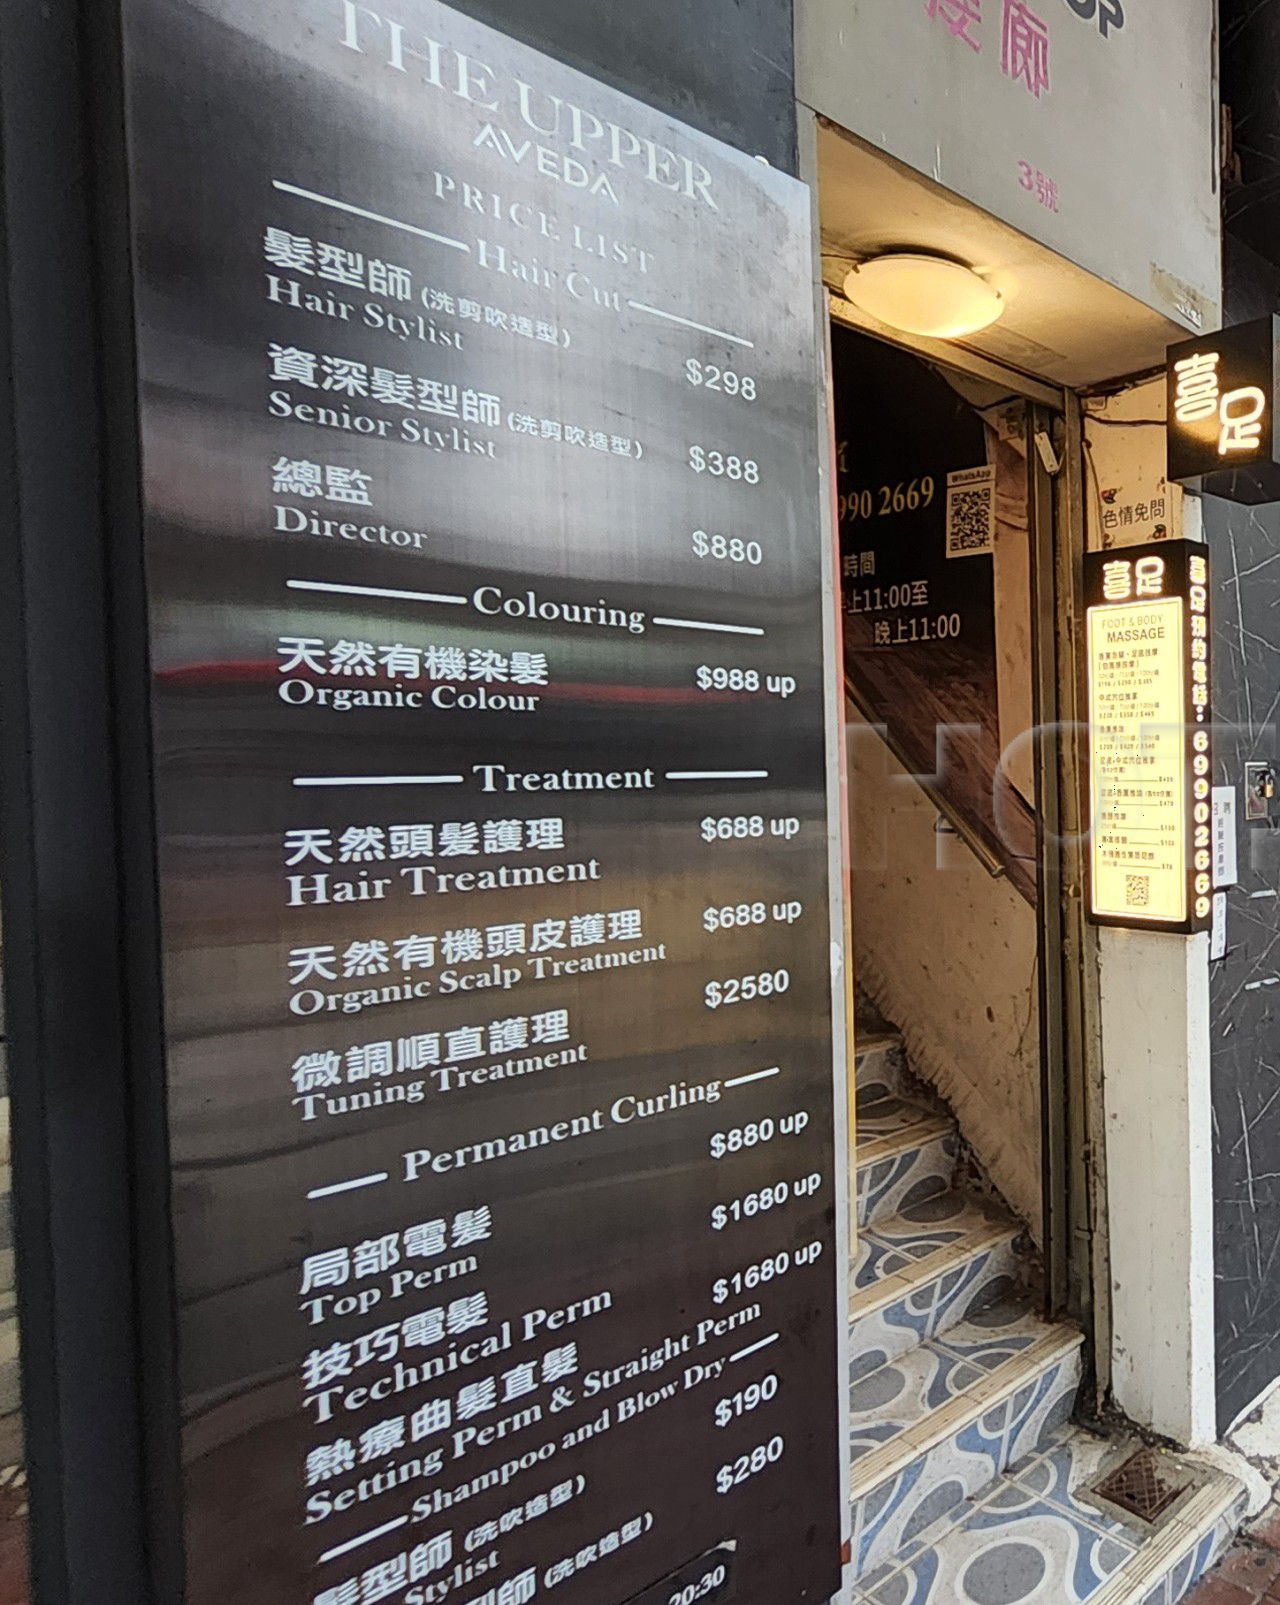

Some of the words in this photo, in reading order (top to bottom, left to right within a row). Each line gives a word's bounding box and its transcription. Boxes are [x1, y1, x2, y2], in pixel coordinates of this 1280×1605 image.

[338, 0, 501, 113] THE
[519, 79, 719, 210] UPPER
[472, 122, 619, 205] AVEDA
[433, 170, 560, 242] PRICE
[573, 225, 654, 275] LIST
[264, 226, 412, 301] 髮型師
[475, 238, 558, 291] Hair
[568, 268, 626, 313] Cut
[265, 274, 355, 321] Hair
[363, 302, 464, 351] Stylist
[267, 342, 501, 428] 資深髮型師
[685, 358, 757, 402] $298
[1174, 352, 1266, 456] 喜足
[268, 390, 391, 437] Senior
[401, 418, 496, 460] Stylist
[271, 456, 373, 507] 總監
[689, 445, 760, 485] $388
[952, 469, 991, 483] WhatsApp
[878, 475, 934, 516] 2669
[1103, 498, 1165, 529] 色情免問
[273, 504, 428, 549] Director
[692, 529, 763, 567] $880
[841, 580, 928, 613] 上11:00至
[1102, 556, 1165, 600] 喜足
[473, 587, 646, 634] Colouring
[874, 613, 960, 644] 晚上11:00
[1101, 617, 1125, 630] FOOT
[1137, 614, 1164, 625] BODY
[1107, 627, 1165, 643] MASSAGE
[277, 636, 550, 687] 天然有機染髮
[696, 665, 760, 695] $988
[766, 672, 797, 699] up
[278, 680, 423, 711] Organic
[431, 686, 541, 713] Colour
[473, 763, 655, 793] Treatment
[284, 817, 565, 868] 天然頭髮護理
[700, 814, 764, 843] $688
[770, 816, 800, 841] up
[285, 872, 391, 908] Hair
[401, 856, 601, 899] Treatment
[703, 902, 767, 933] $688
[773, 898, 803, 926] up
[288, 908, 643, 987] 天然有機頭皮護理
[289, 975, 430, 1018] Organic
[438, 963, 522, 998] Scalp
[527, 943, 667, 981] Treatment
[704, 968, 791, 1010] $2580
[292, 1008, 570, 1094] 微調順直護理
[291, 1074, 425, 1122] Tuning
[431, 1043, 588, 1094] Treatment
[402, 1108, 605, 1184] Permanent
[610, 1078, 723, 1126] Curling
[709, 1115, 775, 1162] $880
[779, 1109, 809, 1140] up
[711, 1184, 789, 1232] $1680
[793, 1170, 822, 1199] up
[299, 1206, 493, 1298] 局部電髮
[712, 1253, 790, 1305] $1680
[794, 1239, 823, 1270] up
[300, 1290, 380, 1328] Top
[389, 1252, 479, 1300] Perm
[301, 1291, 490, 1391] 技巧電髮
[303, 1321, 513, 1427] Technical
[522, 1288, 614, 1340] Perm
[303, 1447, 444, 1528] Setting
[451, 1406, 543, 1462] Perm
[549, 1385, 577, 1414] &
[582, 1331, 692, 1400] Straight
[696, 1301, 762, 1347] Perm
[305, 1341, 578, 1487] 熱療曲髮直髮
[714, 1374, 779, 1428] $190
[409, 1439, 557, 1526] Shampoo
[562, 1409, 612, 1452] and
[617, 1384, 677, 1426] Blow
[683, 1355, 728, 1398] Dry
[715, 1434, 785, 1496] $280
[404, 1549, 501, 1605] Stylist
[668, 1565, 726, 1605] 20:30
